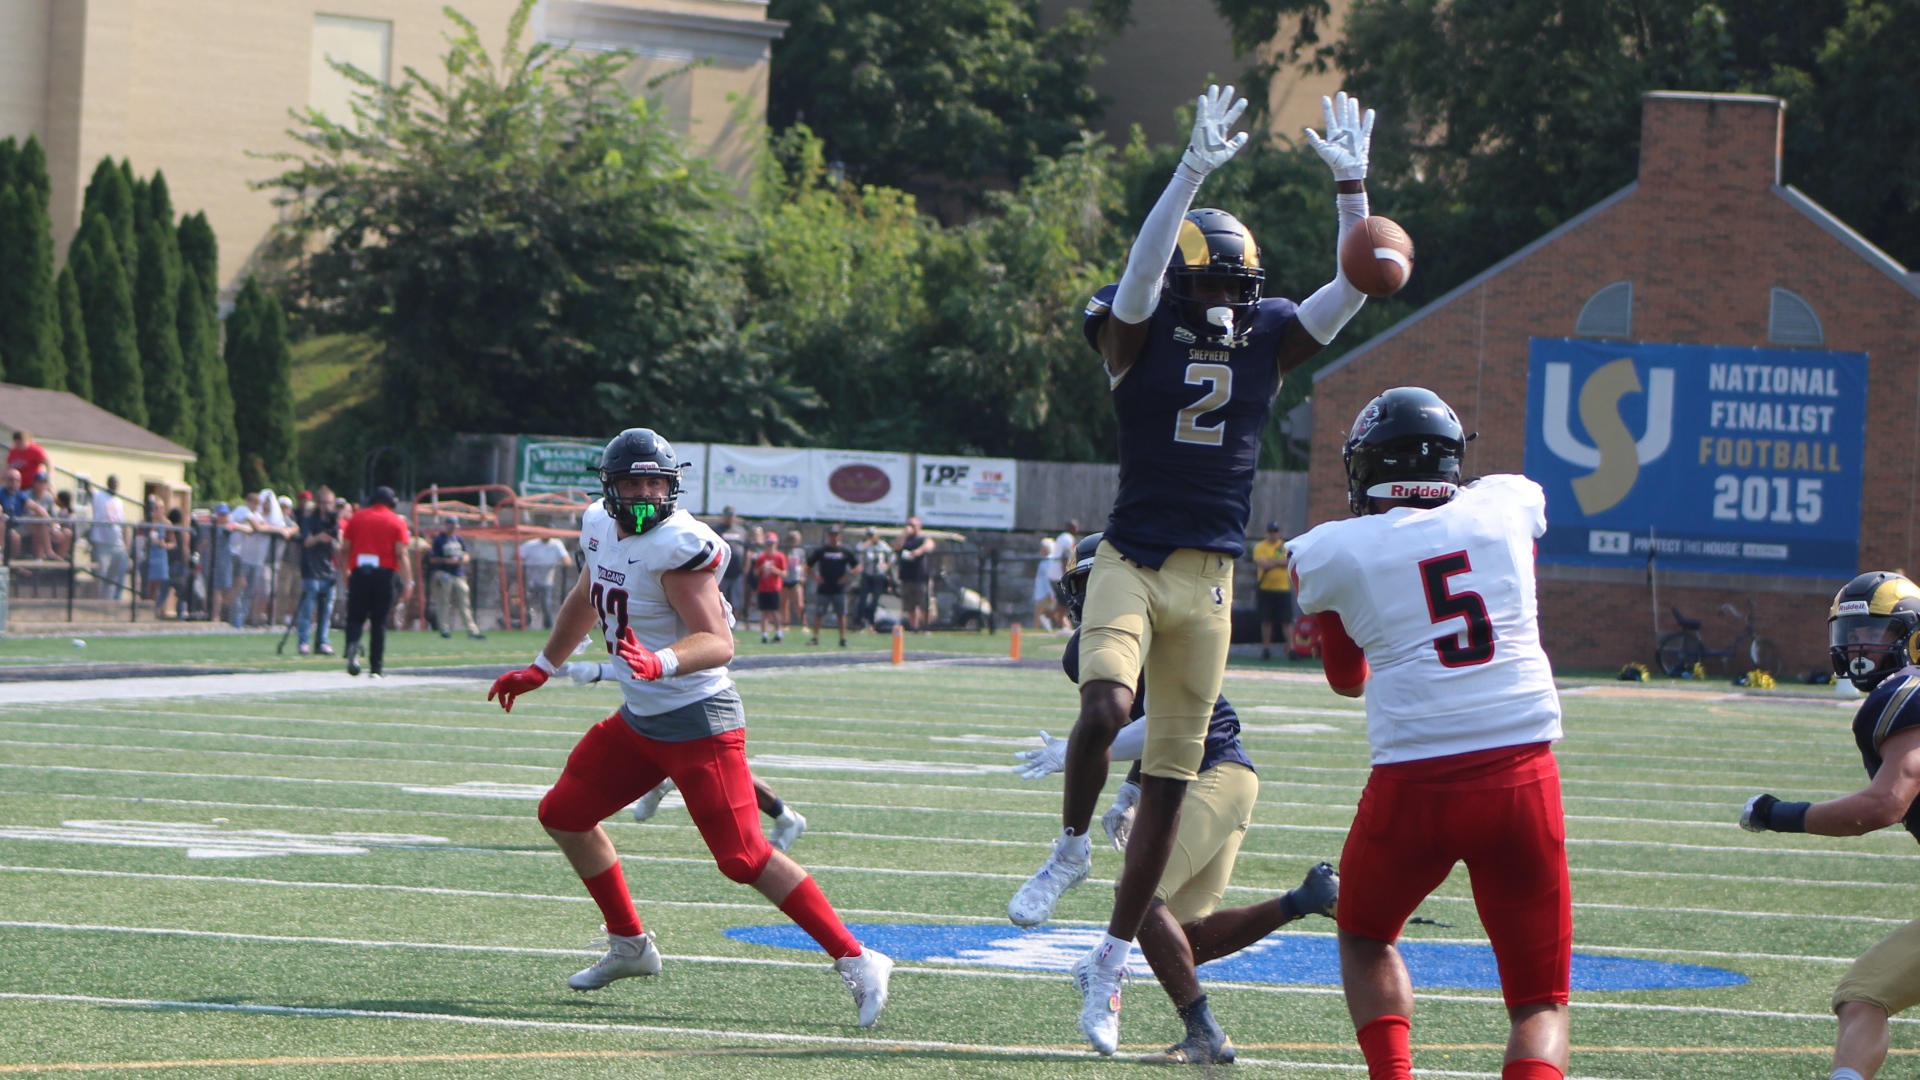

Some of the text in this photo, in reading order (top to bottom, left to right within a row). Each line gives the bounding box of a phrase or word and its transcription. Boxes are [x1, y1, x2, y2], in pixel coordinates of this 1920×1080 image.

[1189, 348, 1230, 362] SHEPHERD
[1708, 363, 1839, 397] NATIONAL
[1174, 363, 1233, 446] 2
[1710, 400, 1835, 433] FINALIST
[1421, 442, 1429, 455] 5
[1698, 437, 1841, 472] FOOTBALL
[713, 472, 799, 489] SMART529
[922, 464, 970, 485] TPF
[1391, 484, 1449, 498] Riddell
[1712, 474, 1823, 524] 2015
[1418, 549, 1496, 668] 5
[1839, 603, 1865, 611] Riddell
